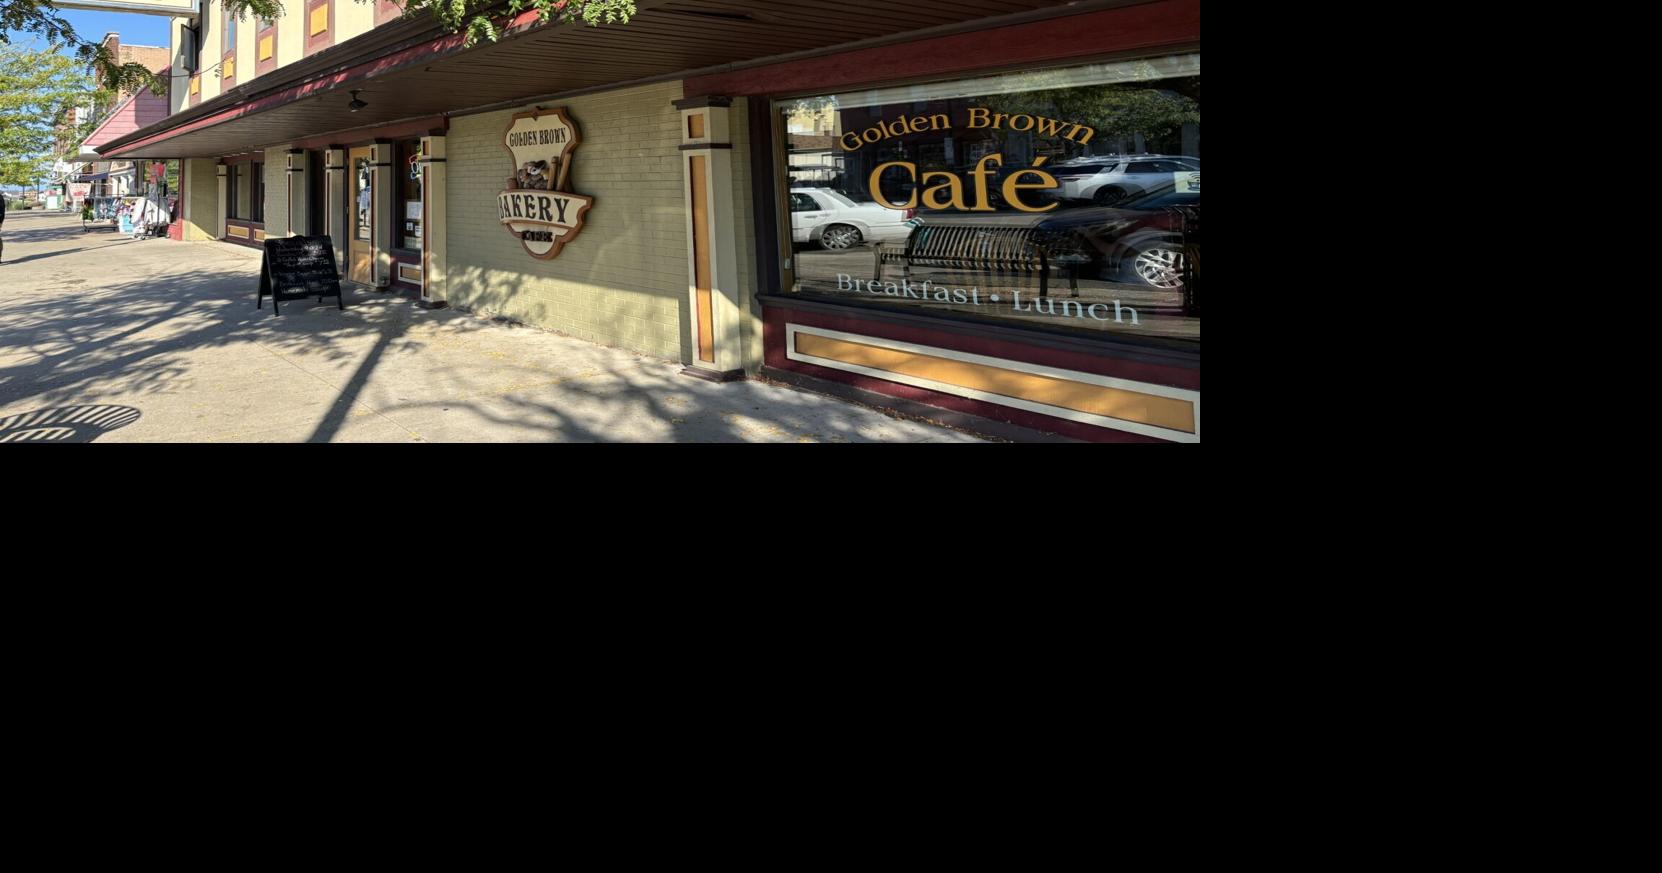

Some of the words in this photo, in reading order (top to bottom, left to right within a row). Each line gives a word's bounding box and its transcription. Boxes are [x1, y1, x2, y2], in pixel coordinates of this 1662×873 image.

[509, 130, 537, 147] GOLDEN
[539, 127, 566, 145] BROWN
[839, 113, 951, 151] Golden
[968, 107, 1095, 145] Brown
[869, 153, 1059, 212] Café
[499, 194, 570, 223] BAKERY
[836, 273, 982, 306] Breakfast
[1012, 290, 1140, 326] Lunch
